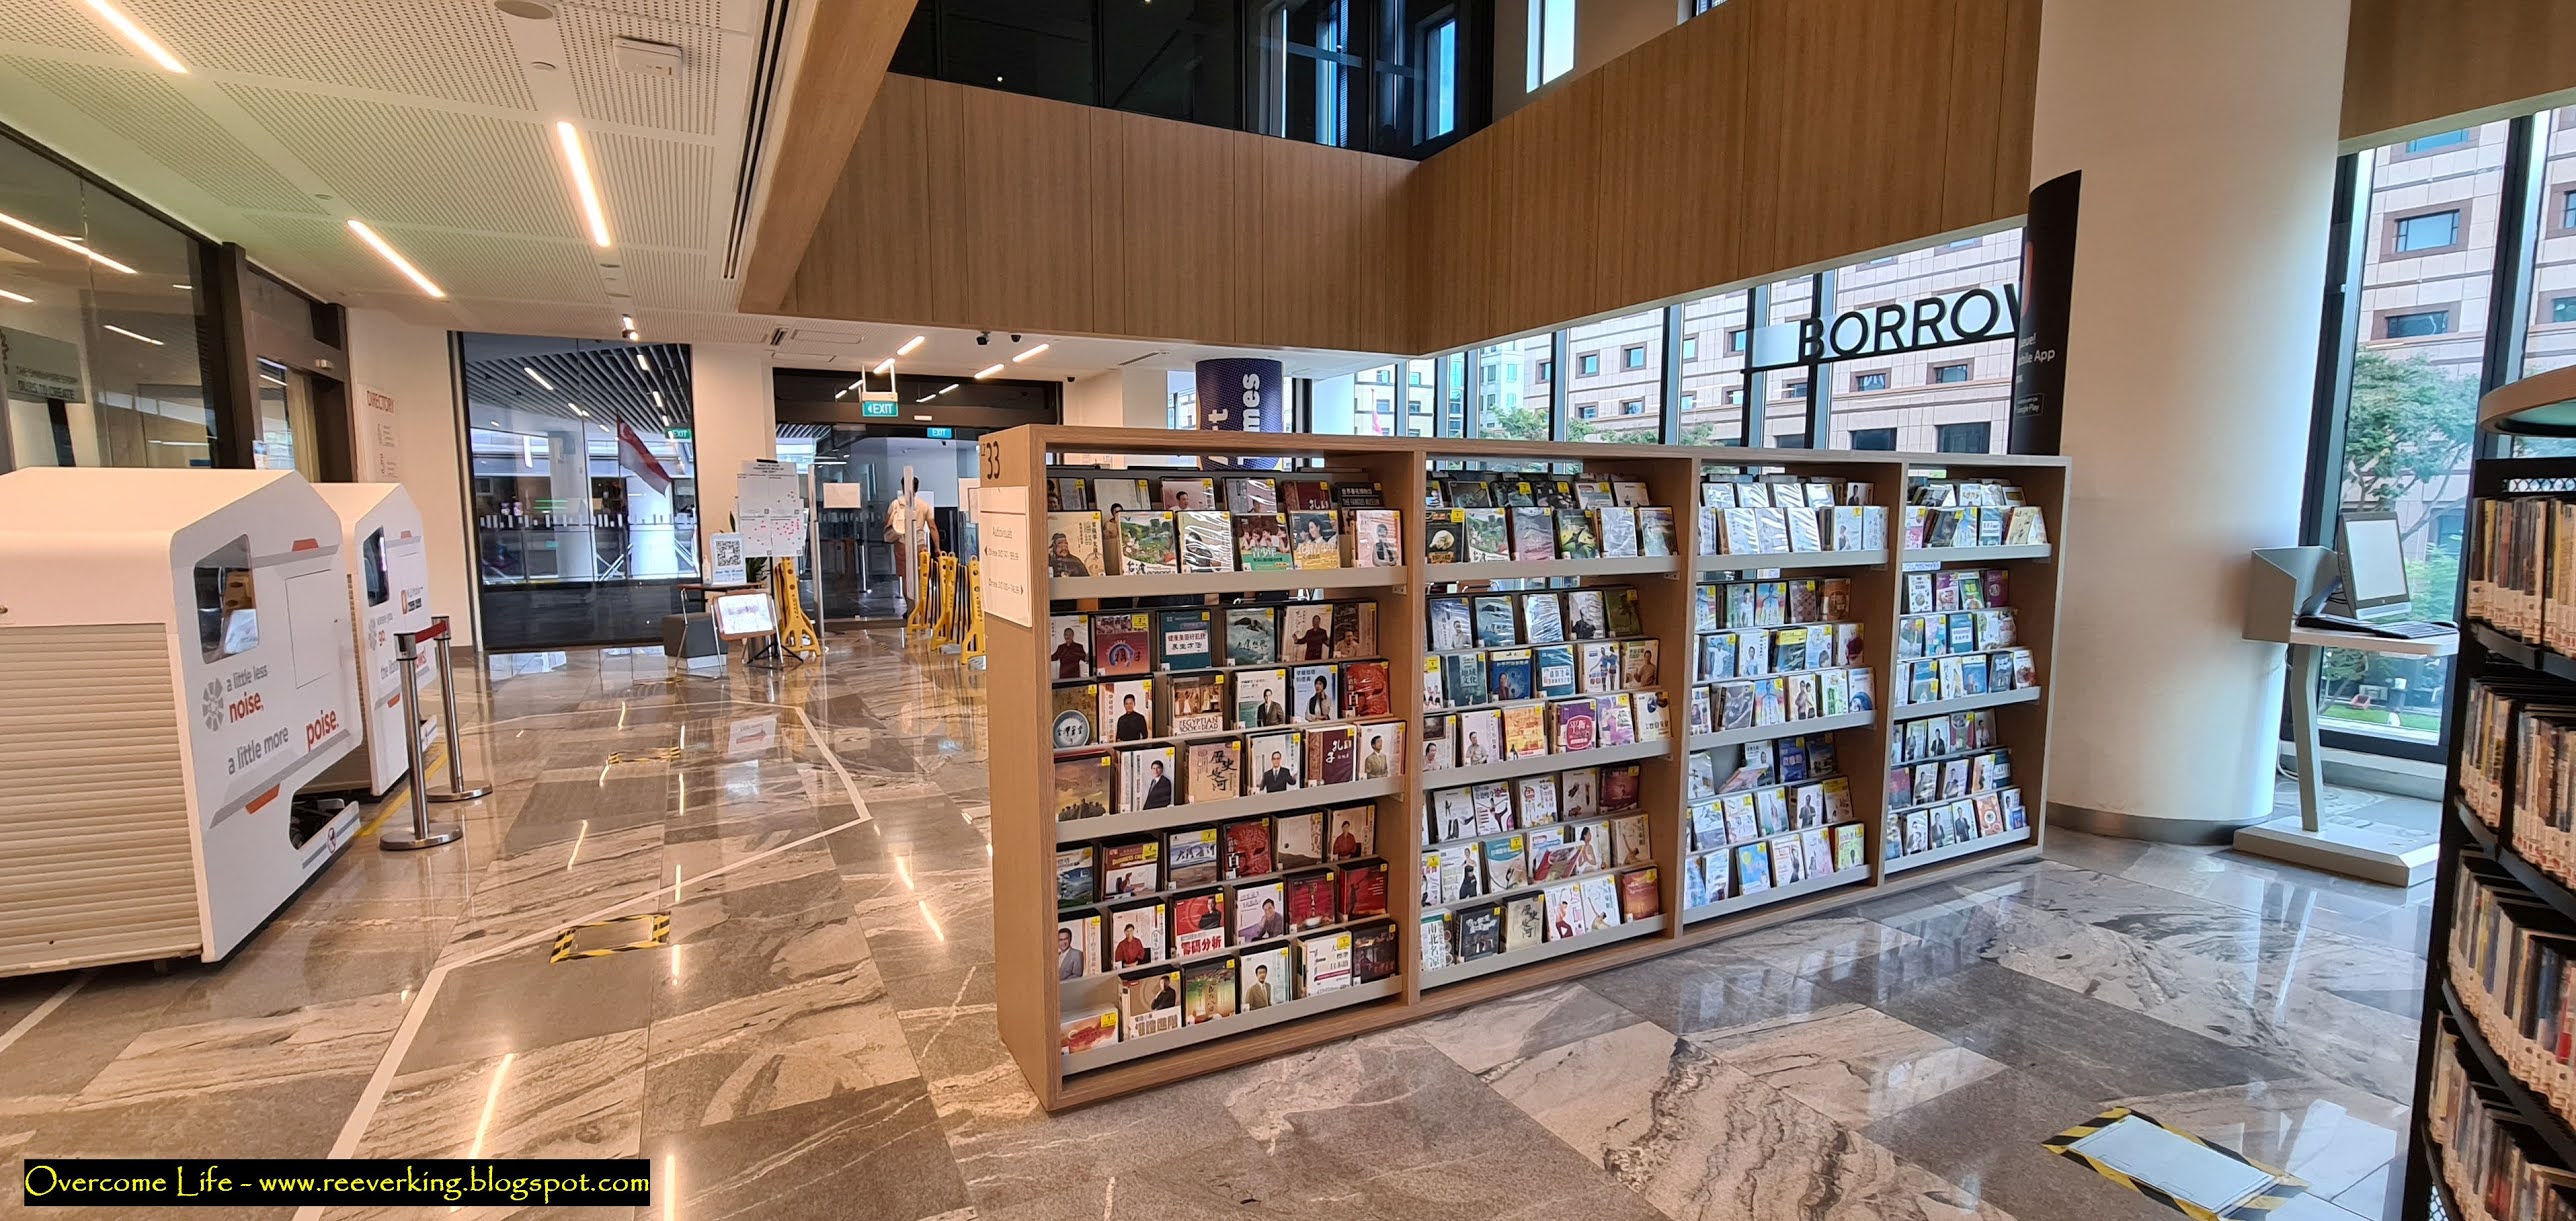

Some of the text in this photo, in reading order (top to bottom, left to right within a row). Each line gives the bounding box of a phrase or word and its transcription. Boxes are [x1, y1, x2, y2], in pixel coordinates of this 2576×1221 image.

[1799, 284, 2020, 362] BORRO
[2034, 349, 2056, 363] App
[872, 403, 893, 414] EXIT
[671, 429, 687, 438] EXIT
[932, 428, 947, 436] EXIT
[986, 441, 1001, 480] 33
[226, 664, 269, 692] a little less
[305, 709, 340, 752] poise.
[228, 727, 289, 775] a little more
